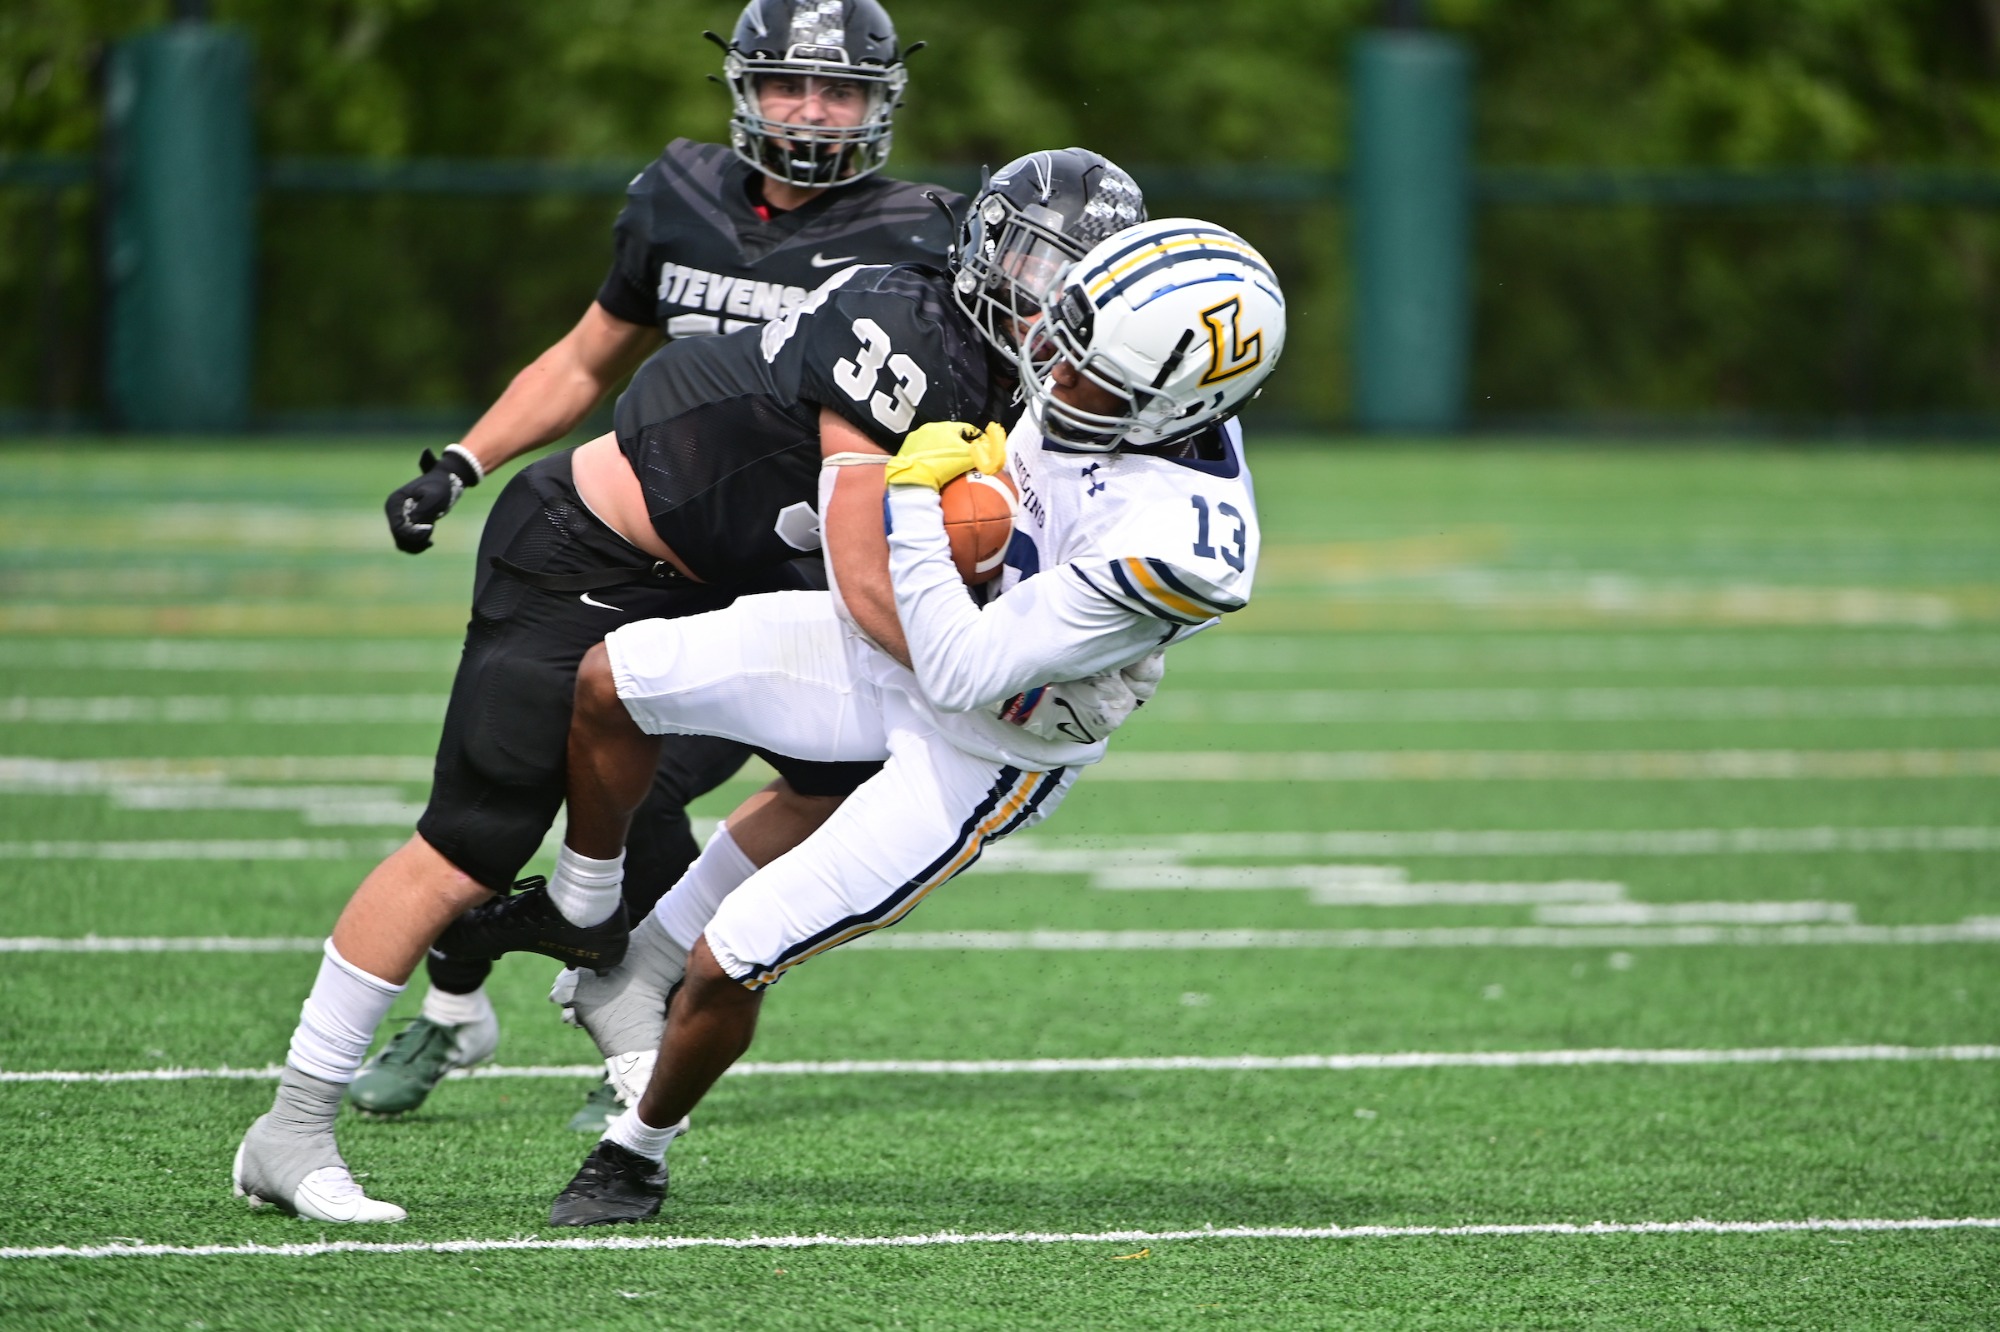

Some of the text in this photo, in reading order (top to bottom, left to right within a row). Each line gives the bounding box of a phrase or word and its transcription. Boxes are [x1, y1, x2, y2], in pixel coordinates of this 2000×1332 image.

[657, 261, 808, 319] STEVENS
[833, 318, 928, 435] 33
[1198, 294, 1263, 389] L
[1190, 494, 1246, 573] 13
